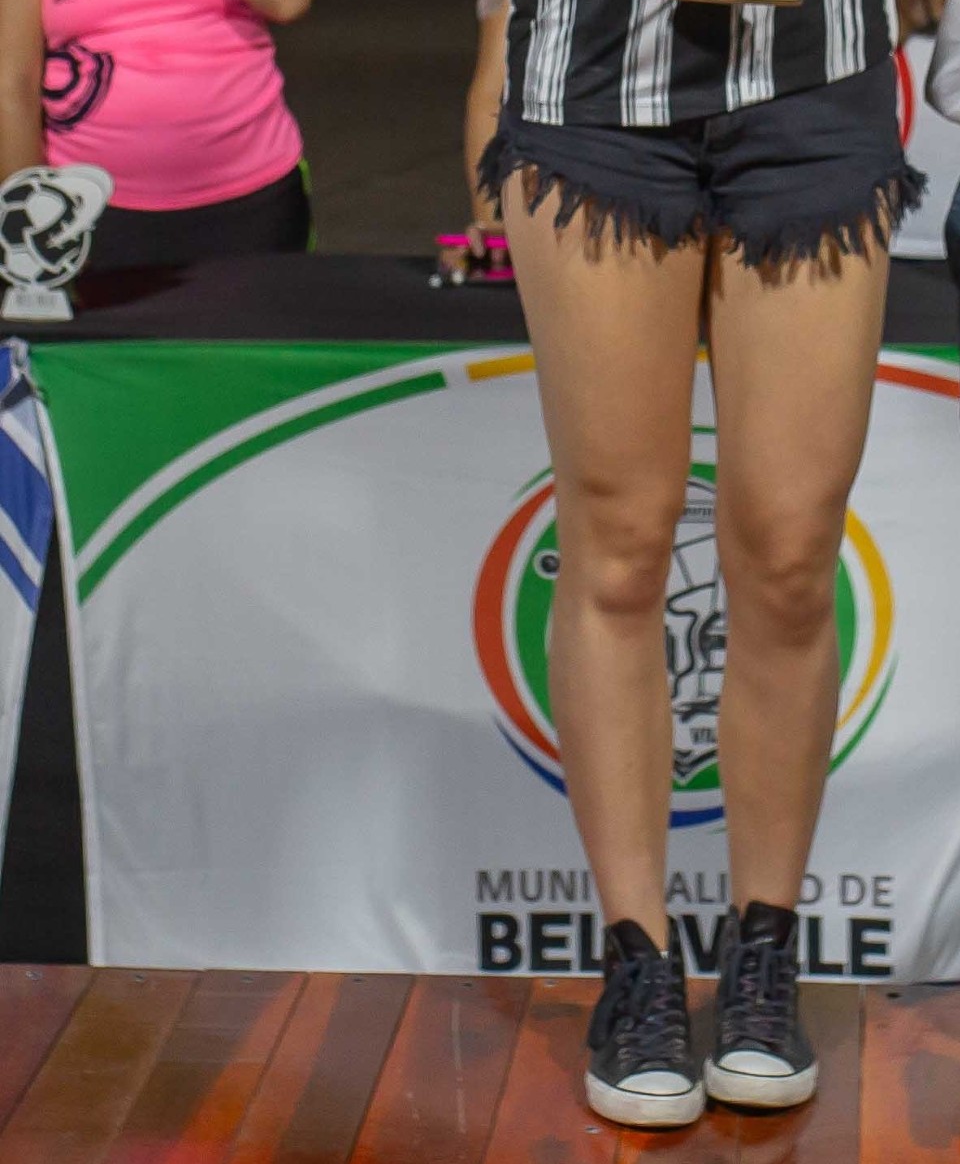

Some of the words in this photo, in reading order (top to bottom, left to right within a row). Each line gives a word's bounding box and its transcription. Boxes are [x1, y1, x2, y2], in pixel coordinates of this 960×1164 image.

[476, 869, 823, 904] MUNIALID
[840, 874, 893, 907] DE
[478, 913, 606, 971] BEL
[680, 914, 892, 975] VLE
